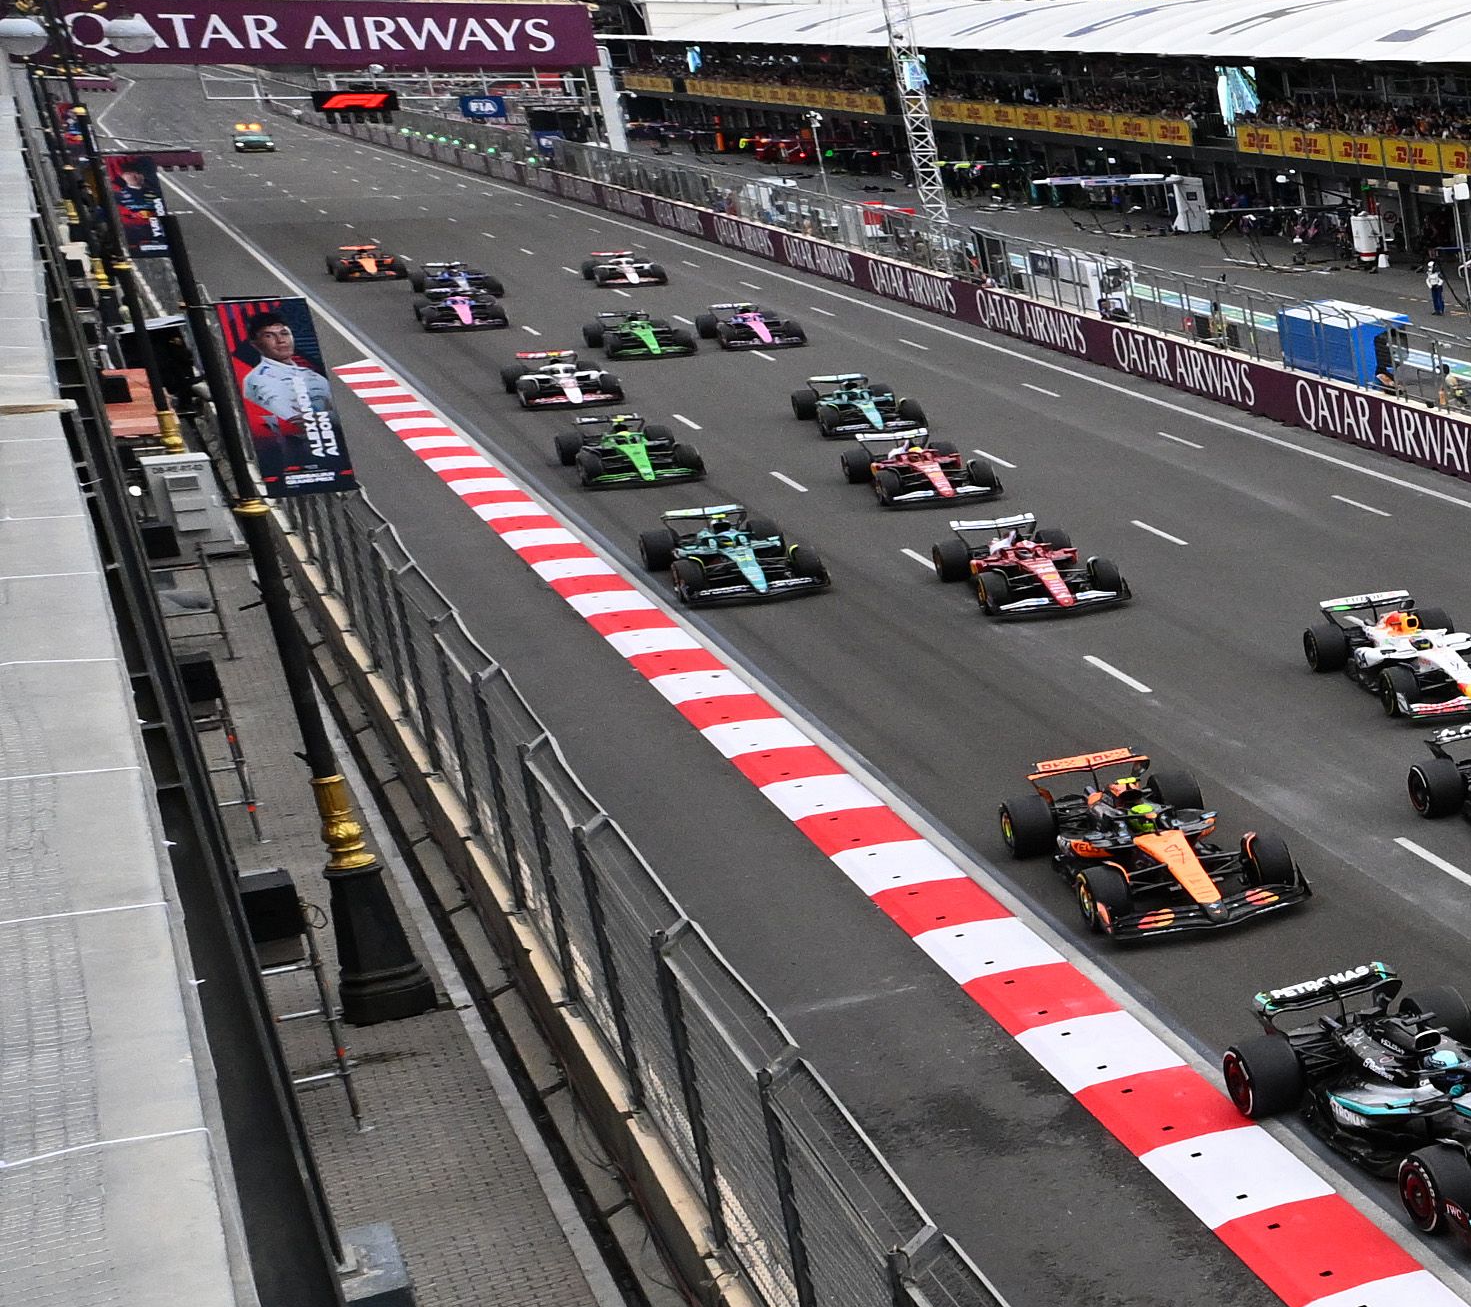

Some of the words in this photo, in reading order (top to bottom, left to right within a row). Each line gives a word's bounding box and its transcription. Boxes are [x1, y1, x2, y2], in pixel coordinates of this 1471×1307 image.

[64, 12, 287, 57] QATAR
[304, 16, 555, 52] AIRWAYS
[470, 102, 495, 114] FIA
[1396, 146, 1427, 164] DHL
[868, 259, 905, 296] QATAR
[906, 269, 957, 314] AIRWAYS
[976, 289, 1023, 333] QATAR
[1024, 301, 1087, 354] AIRWAYS
[1112, 327, 1170, 380] QATAR
[1176, 341, 1255, 406] AIRWAYS
[317, 411, 340, 456] ALBON
[1295, 379, 1372, 450] QATAR
[1270, 965, 1370, 999] PETRONAS
[1446, 1204, 1462, 1220] IWC
